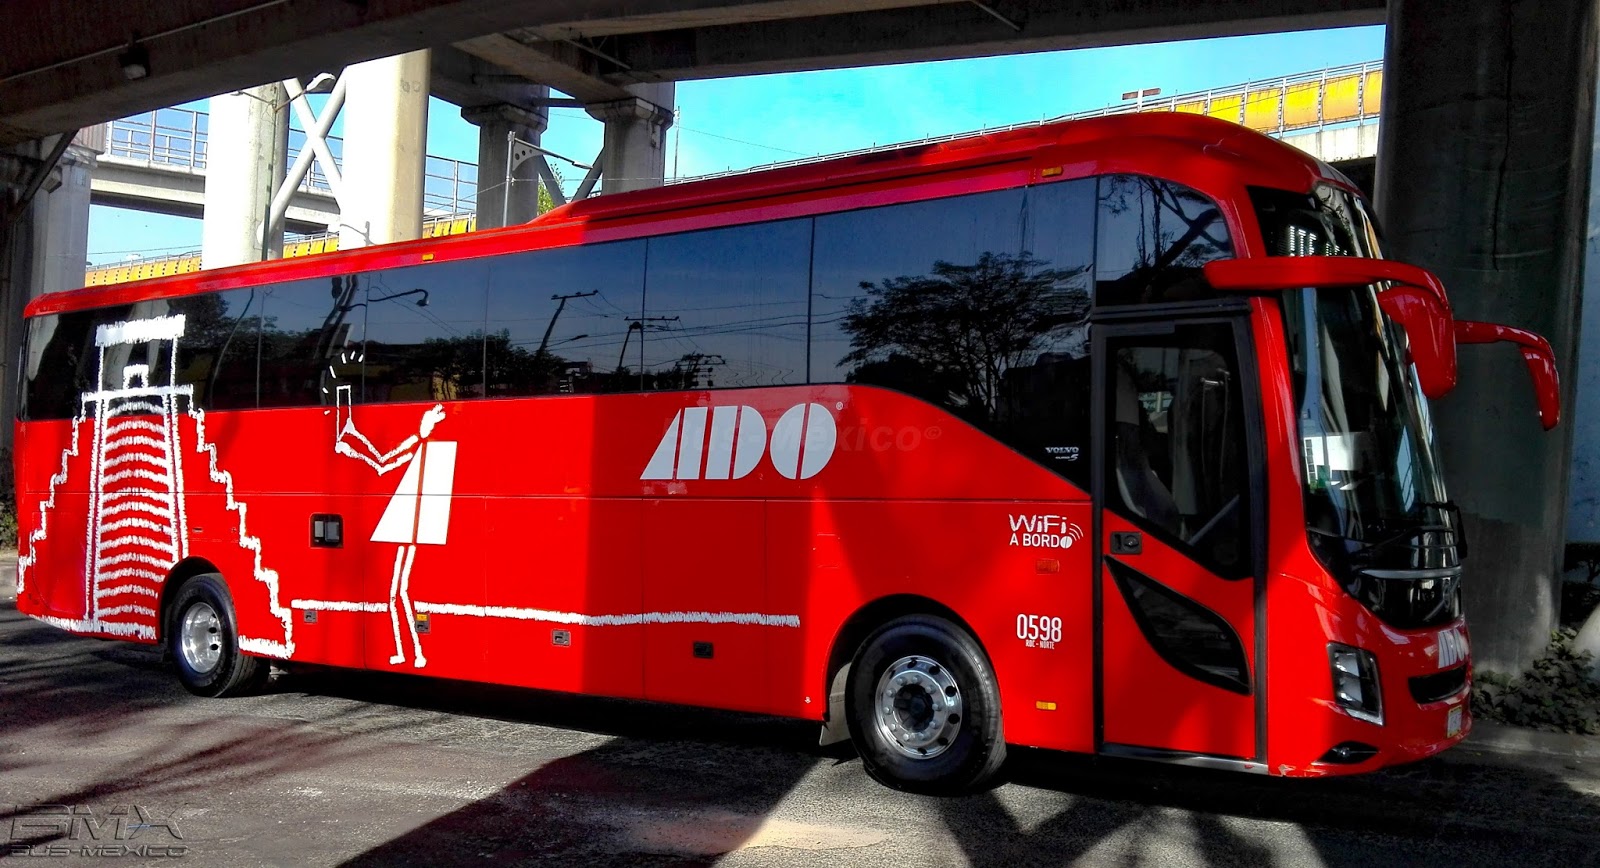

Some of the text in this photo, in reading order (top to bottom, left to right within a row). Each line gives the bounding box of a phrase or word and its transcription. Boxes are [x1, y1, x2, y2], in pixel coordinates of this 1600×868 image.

[640, 402, 837, 480] ADO
[1045, 446, 1079, 454] VOLVO
[1008, 513, 1067, 534] WiFi
[1009, 533, 1073, 549] A BORDO
[1016, 613, 1062, 643] 0598
